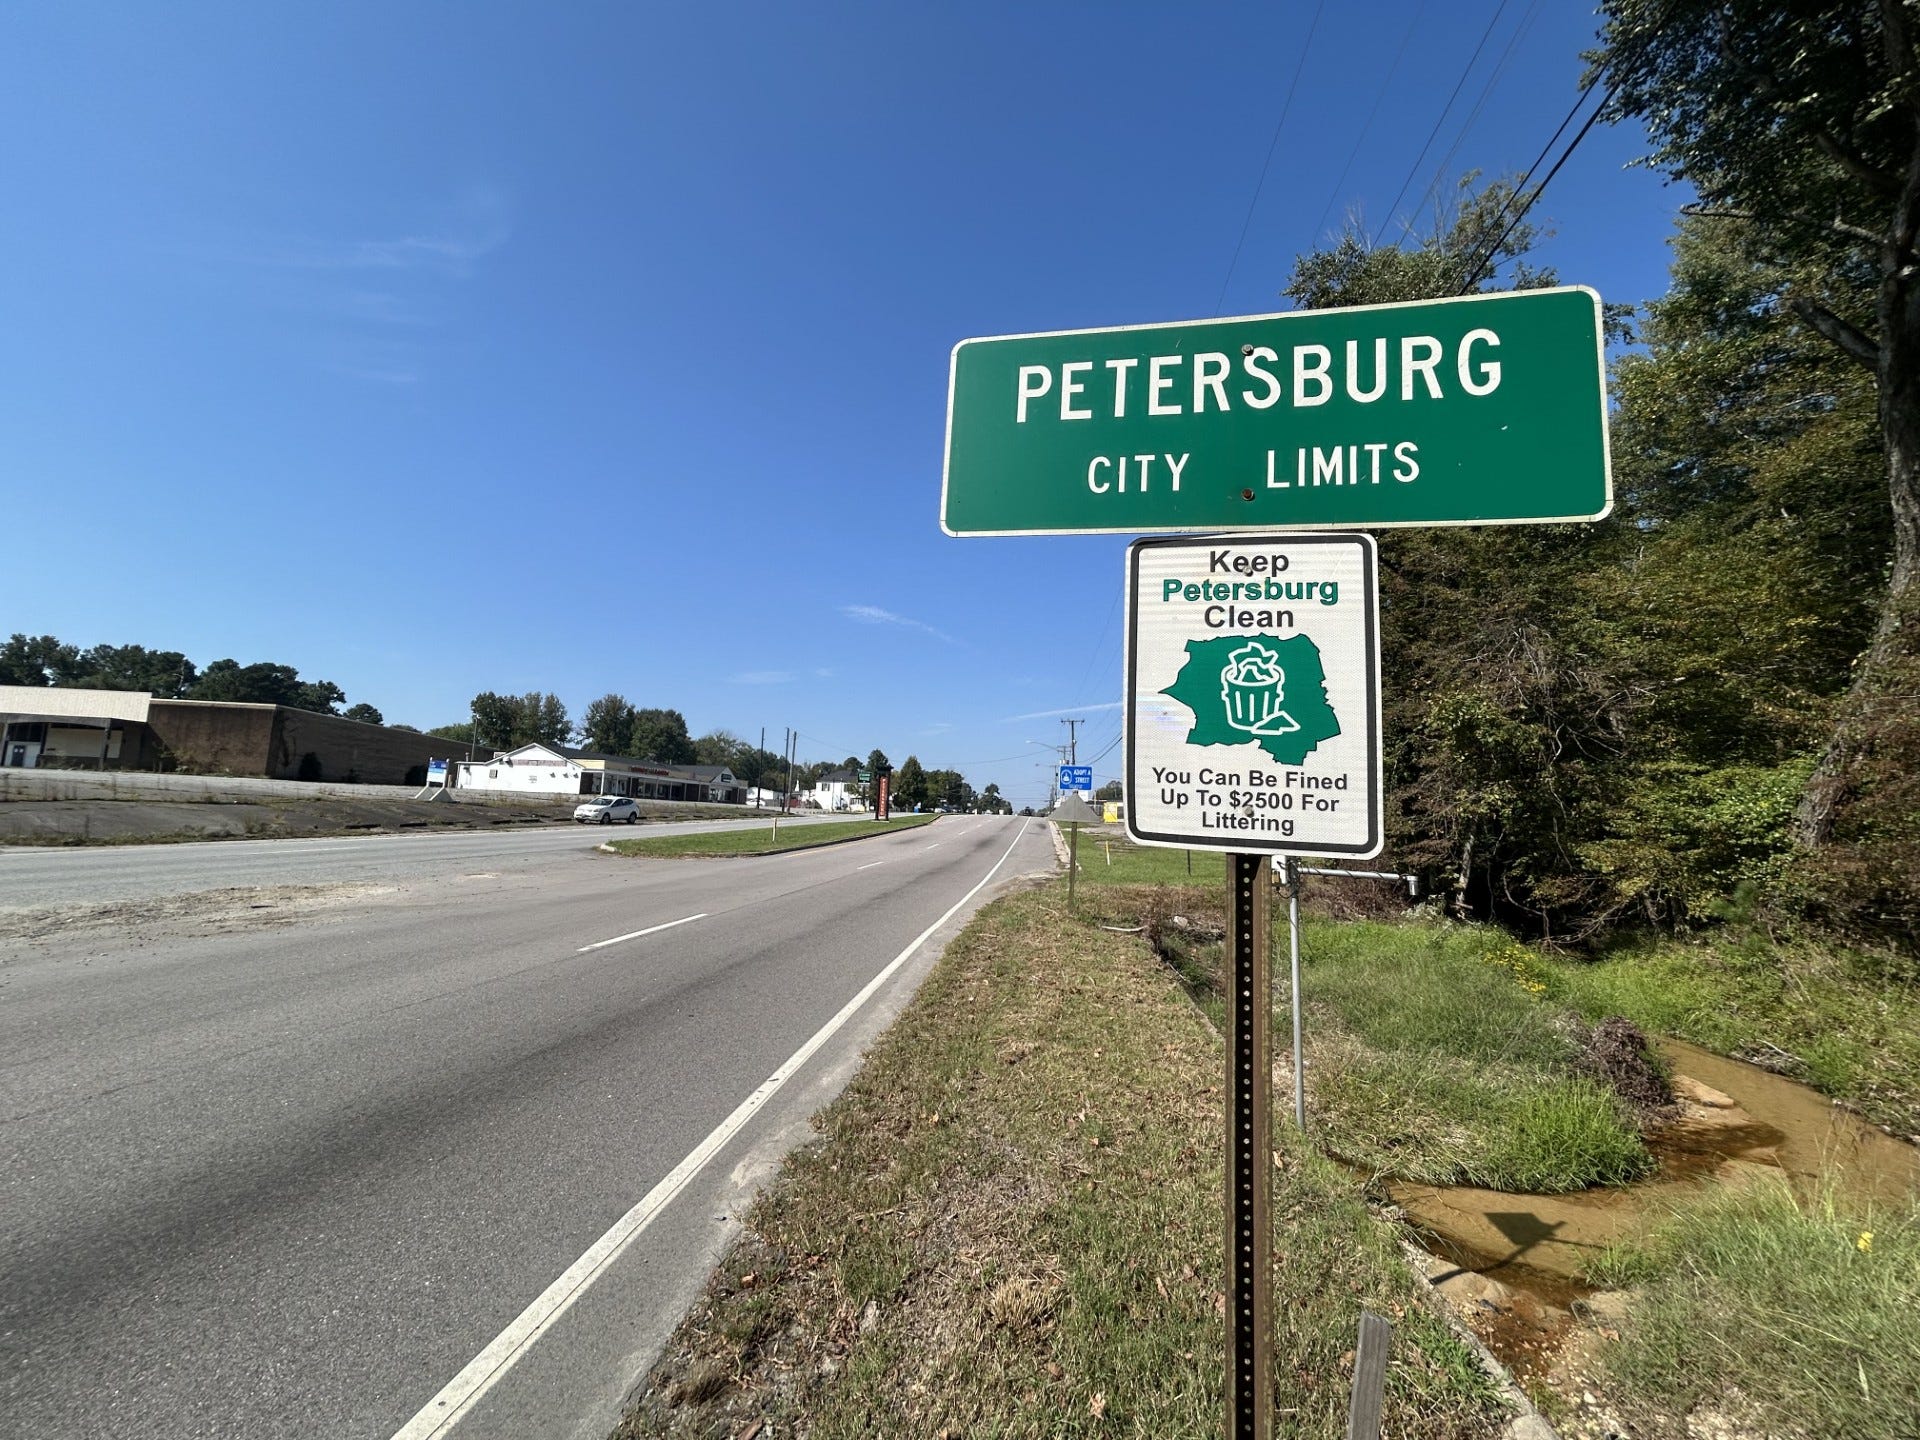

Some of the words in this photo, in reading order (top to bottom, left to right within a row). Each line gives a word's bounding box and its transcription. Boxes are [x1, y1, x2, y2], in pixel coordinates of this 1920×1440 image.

[1016, 328, 1501, 423] PETERSBURG
[1088, 453, 1190, 494] CITY
[1267, 441, 1420, 488] LIMITS
[1209, 550, 1289, 577] Keep
[1162, 577, 1338, 605] Petersburg
[1204, 605, 1294, 628] Clean
[1152, 767, 1191, 785] You
[1199, 768, 1241, 786] Can
[1249, 770, 1277, 787] Be
[1285, 771, 1348, 790] Fined
[1161, 789, 1189, 808] Up
[1196, 790, 1222, 807] To
[1229, 791, 1293, 810] $2500
[1301, 794, 1340, 812] For
[1202, 812, 1294, 836] Littering
